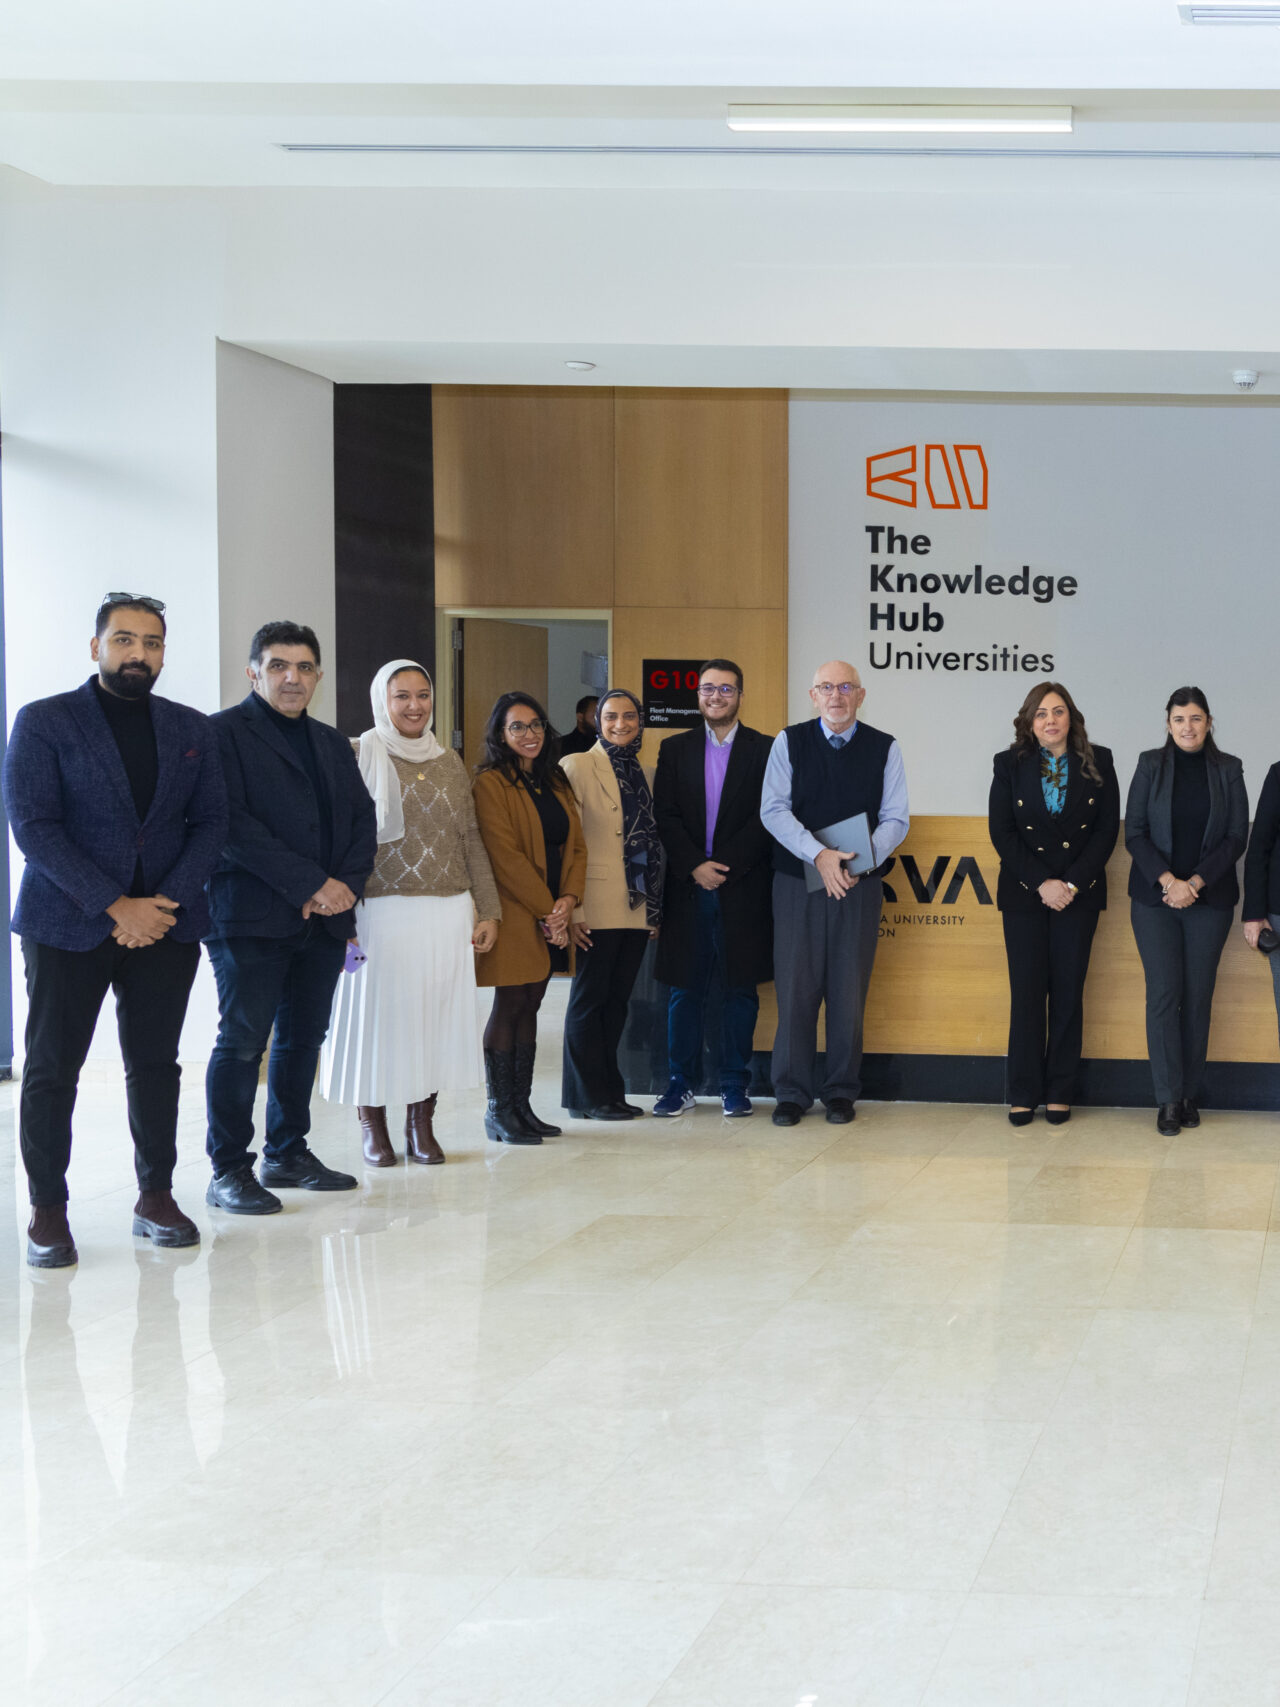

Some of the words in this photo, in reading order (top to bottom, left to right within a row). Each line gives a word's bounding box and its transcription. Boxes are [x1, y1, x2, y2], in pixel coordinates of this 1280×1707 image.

[865, 525, 931, 555] The
[870, 564, 1078, 603] Knowledge
[870, 602, 944, 633] Hub
[869, 642, 1055, 673] Universities
[650, 670, 699, 690] G10
[893, 914, 965, 926] UNIVERSITY
